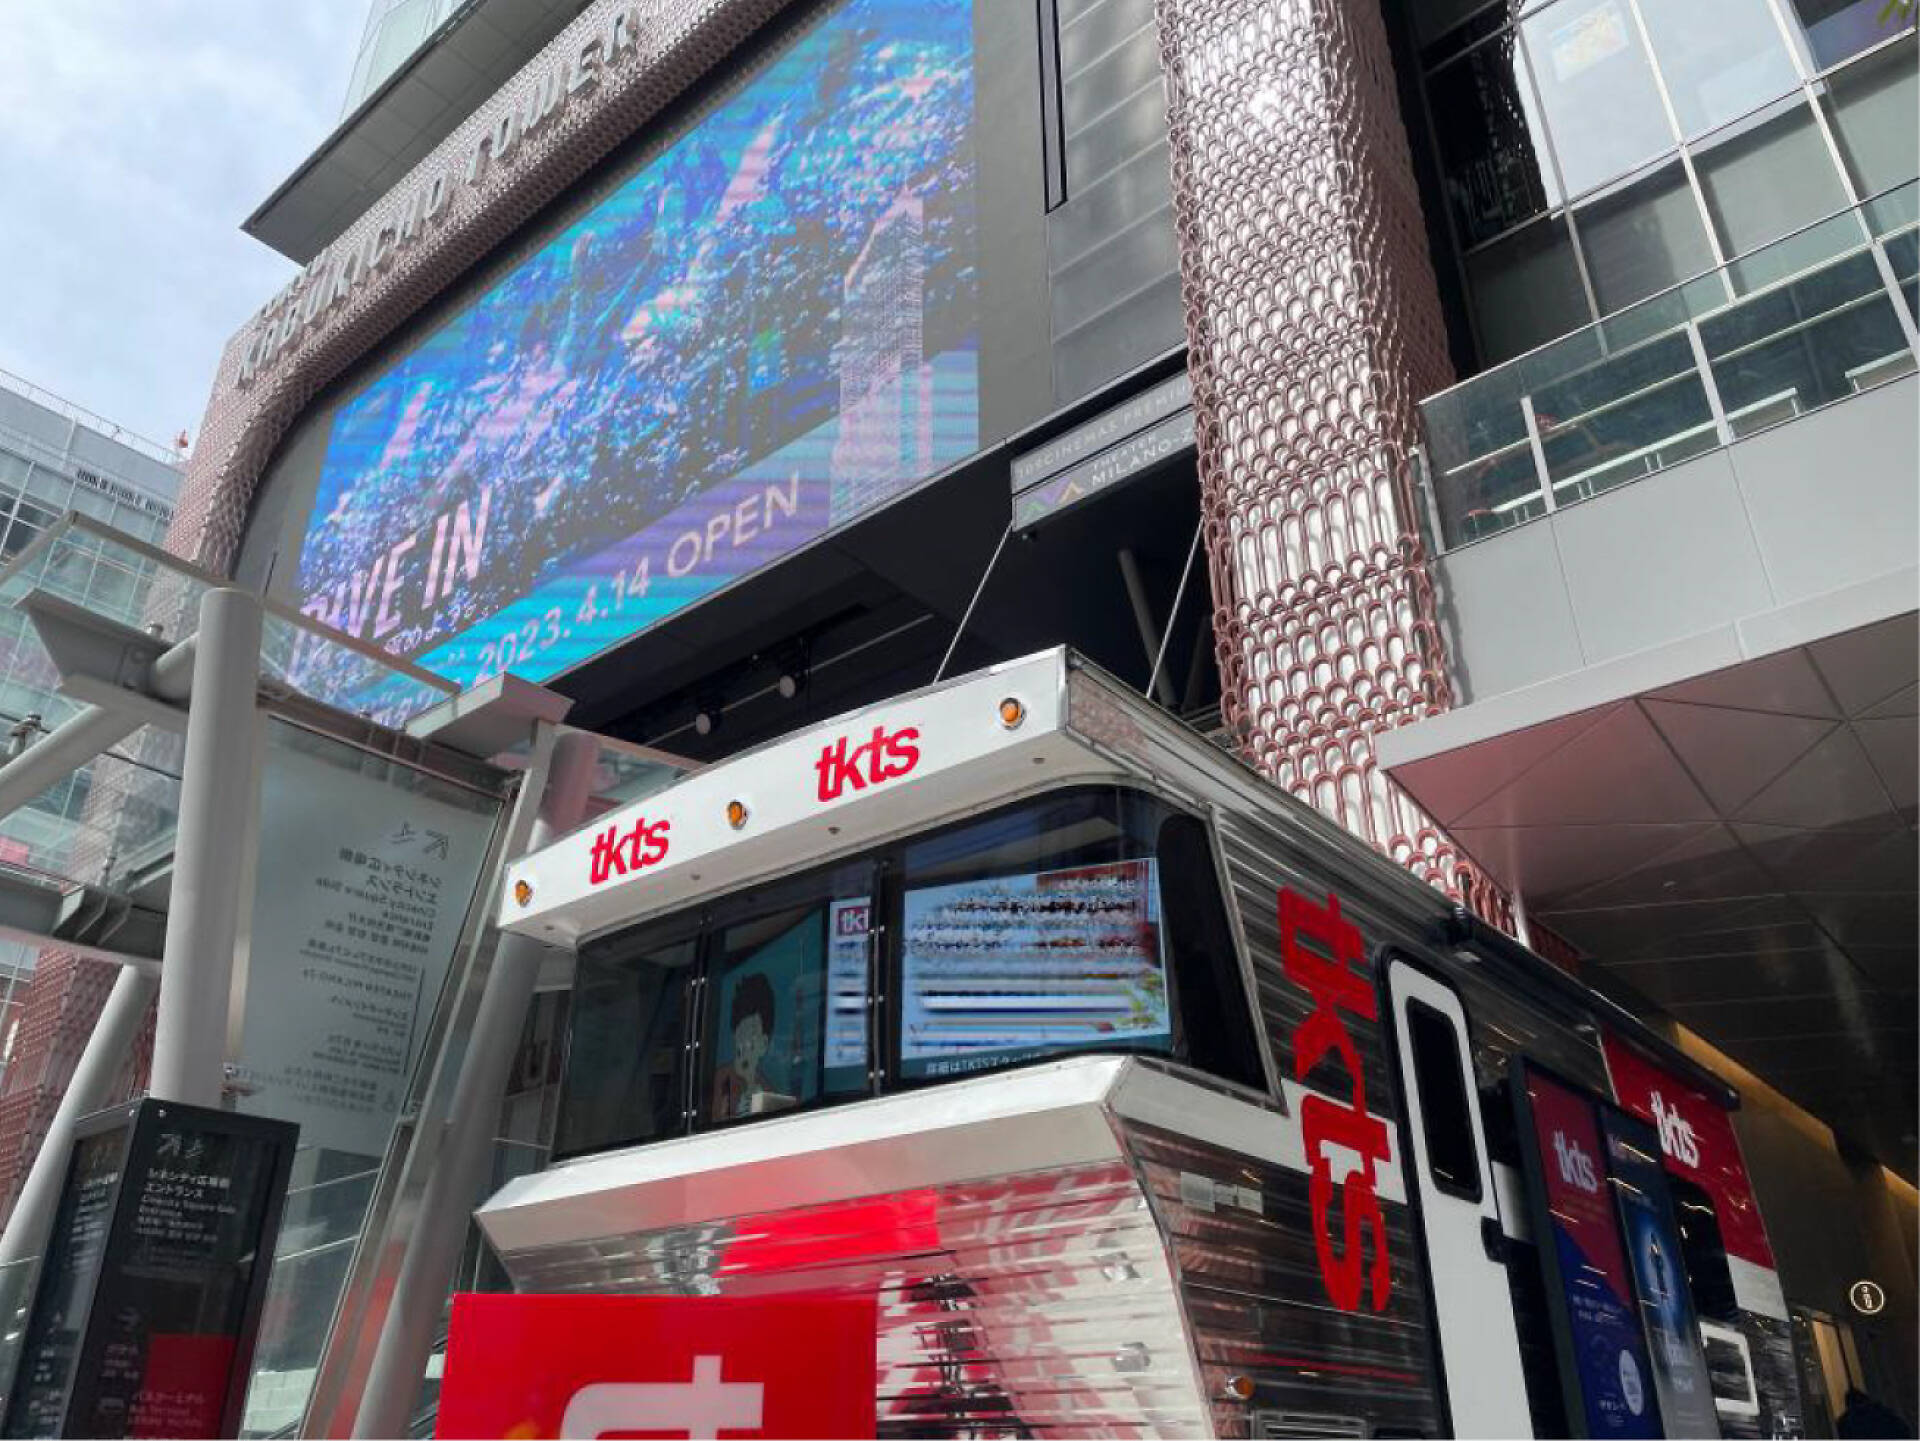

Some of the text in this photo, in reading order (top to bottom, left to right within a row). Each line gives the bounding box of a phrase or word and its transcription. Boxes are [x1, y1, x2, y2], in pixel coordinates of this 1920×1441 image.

[422, 484, 492, 609] IN
[666, 471, 800, 578] OPEN
[814, 725, 921, 803] tkts
[589, 817, 671, 885] tkts
[1276, 885, 1390, 1312] tkts
[1651, 1090, 1700, 1169] tkts
[1553, 1130, 1599, 1194] tkts
